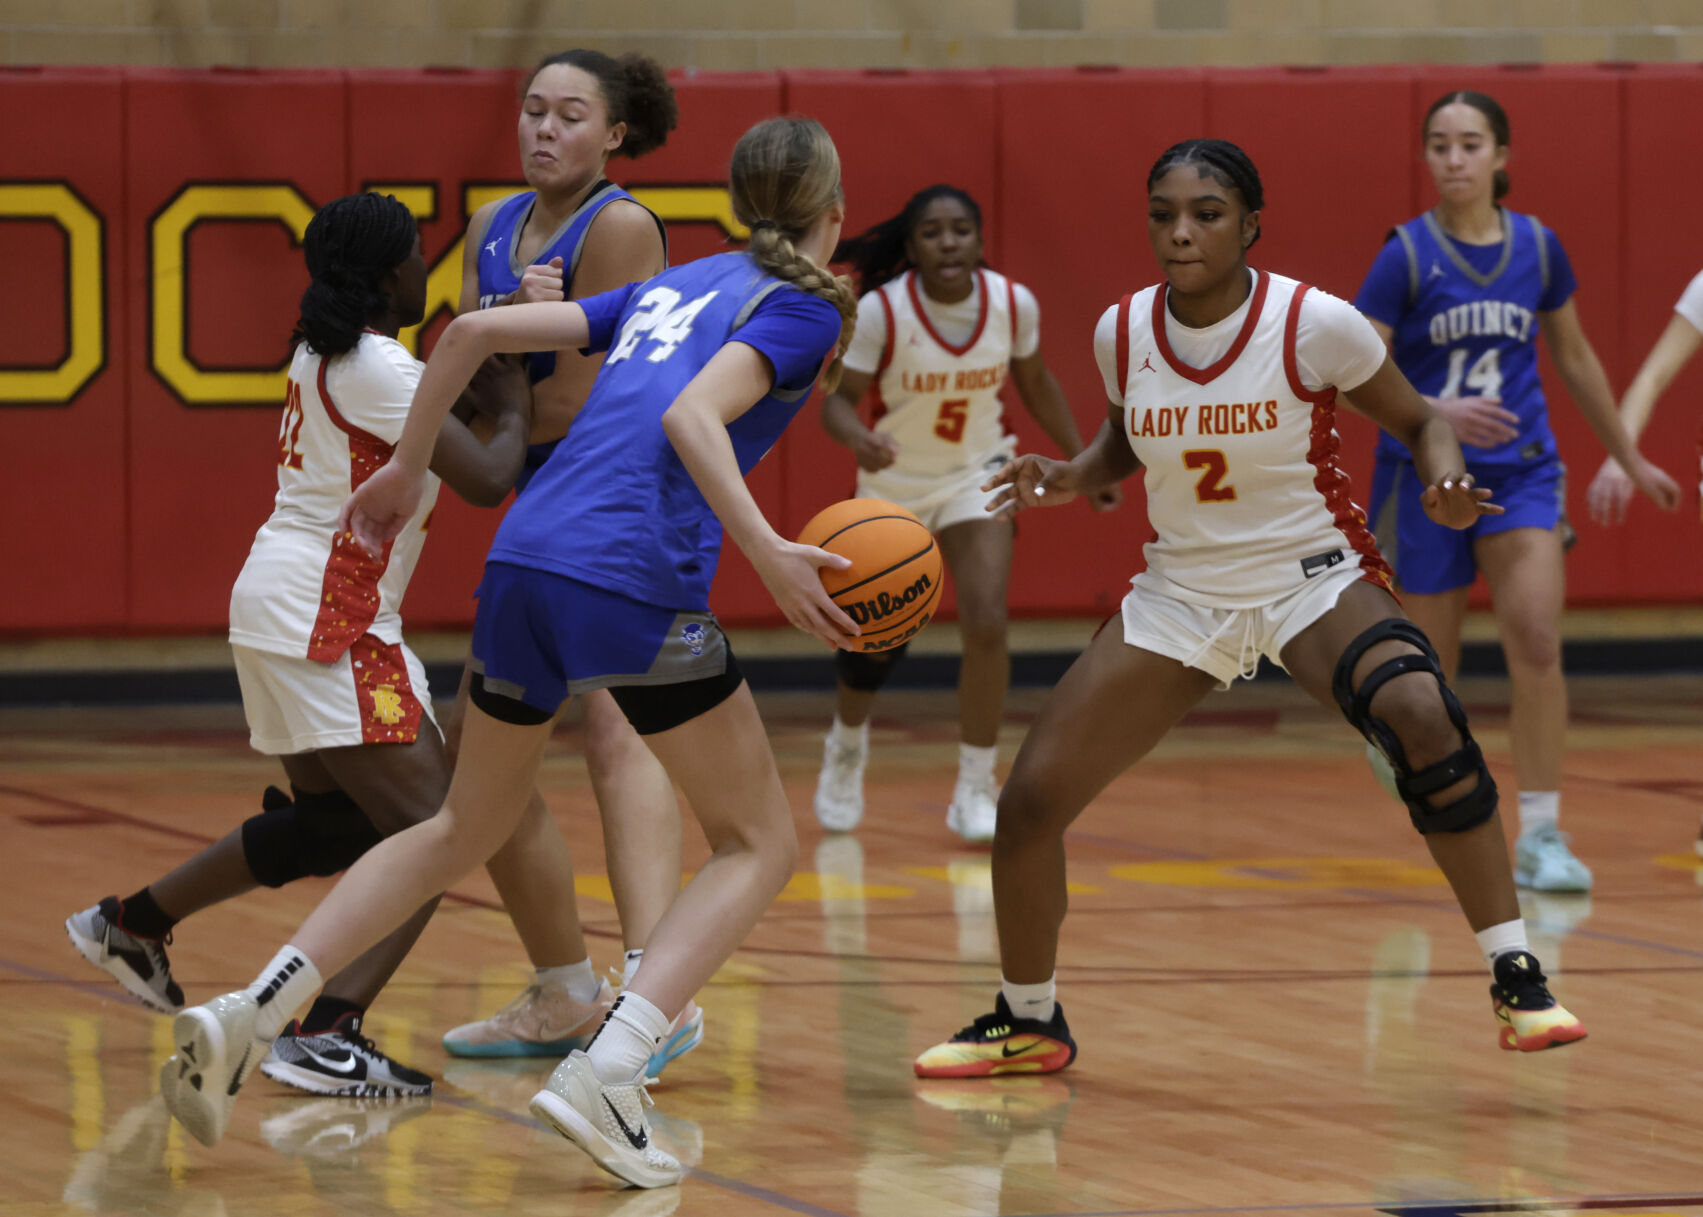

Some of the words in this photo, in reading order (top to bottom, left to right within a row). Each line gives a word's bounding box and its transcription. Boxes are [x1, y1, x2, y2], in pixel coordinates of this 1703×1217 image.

[605, 286, 721, 366] 24
[901, 369, 949, 394] LADY
[1438, 347, 1503, 400] 14
[933, 397, 971, 444] 5
[1131, 406, 1189, 437] LADY
[1198, 400, 1278, 435] ROCKS
[1181, 448, 1238, 504] 2
[1330, 555, 1340, 565] M
[840, 573, 932, 625] Wilson
